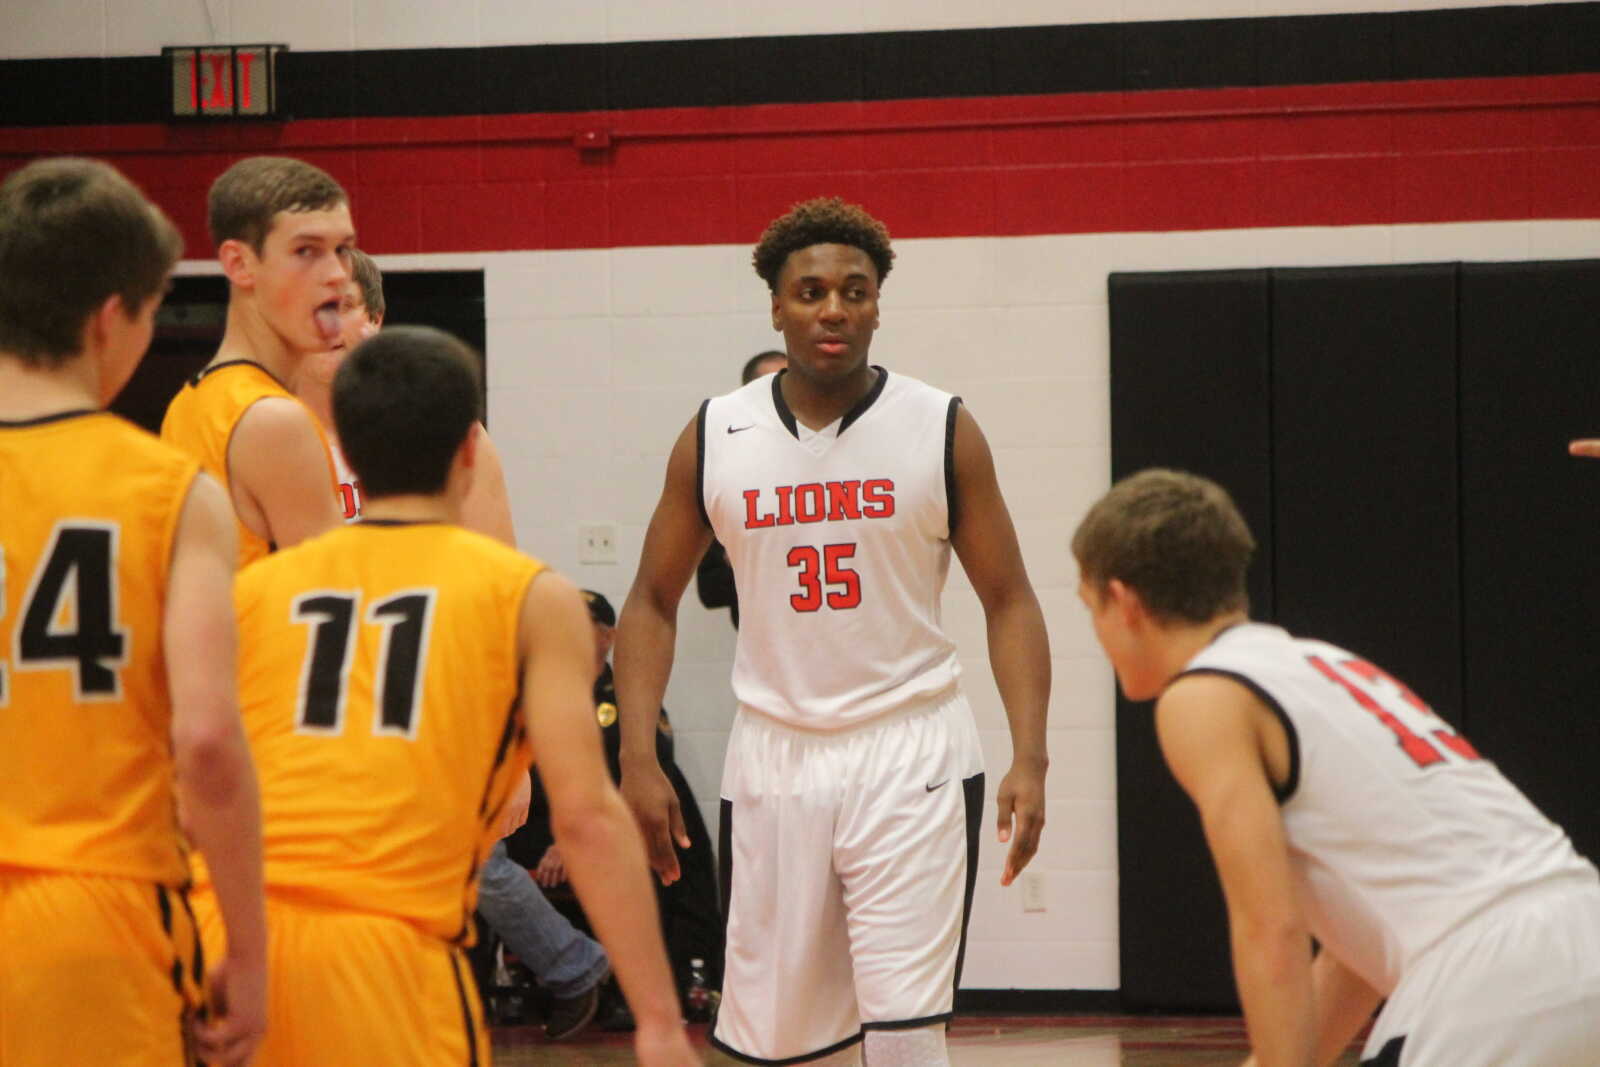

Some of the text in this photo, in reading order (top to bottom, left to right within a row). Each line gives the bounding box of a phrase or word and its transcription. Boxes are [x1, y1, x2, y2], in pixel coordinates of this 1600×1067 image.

[190, 52, 256, 108] EXIT
[742, 478, 896, 529] LIONS
[0, 517, 133, 708] 4
[786, 542, 862, 613] 35
[290, 586, 438, 741] 11
